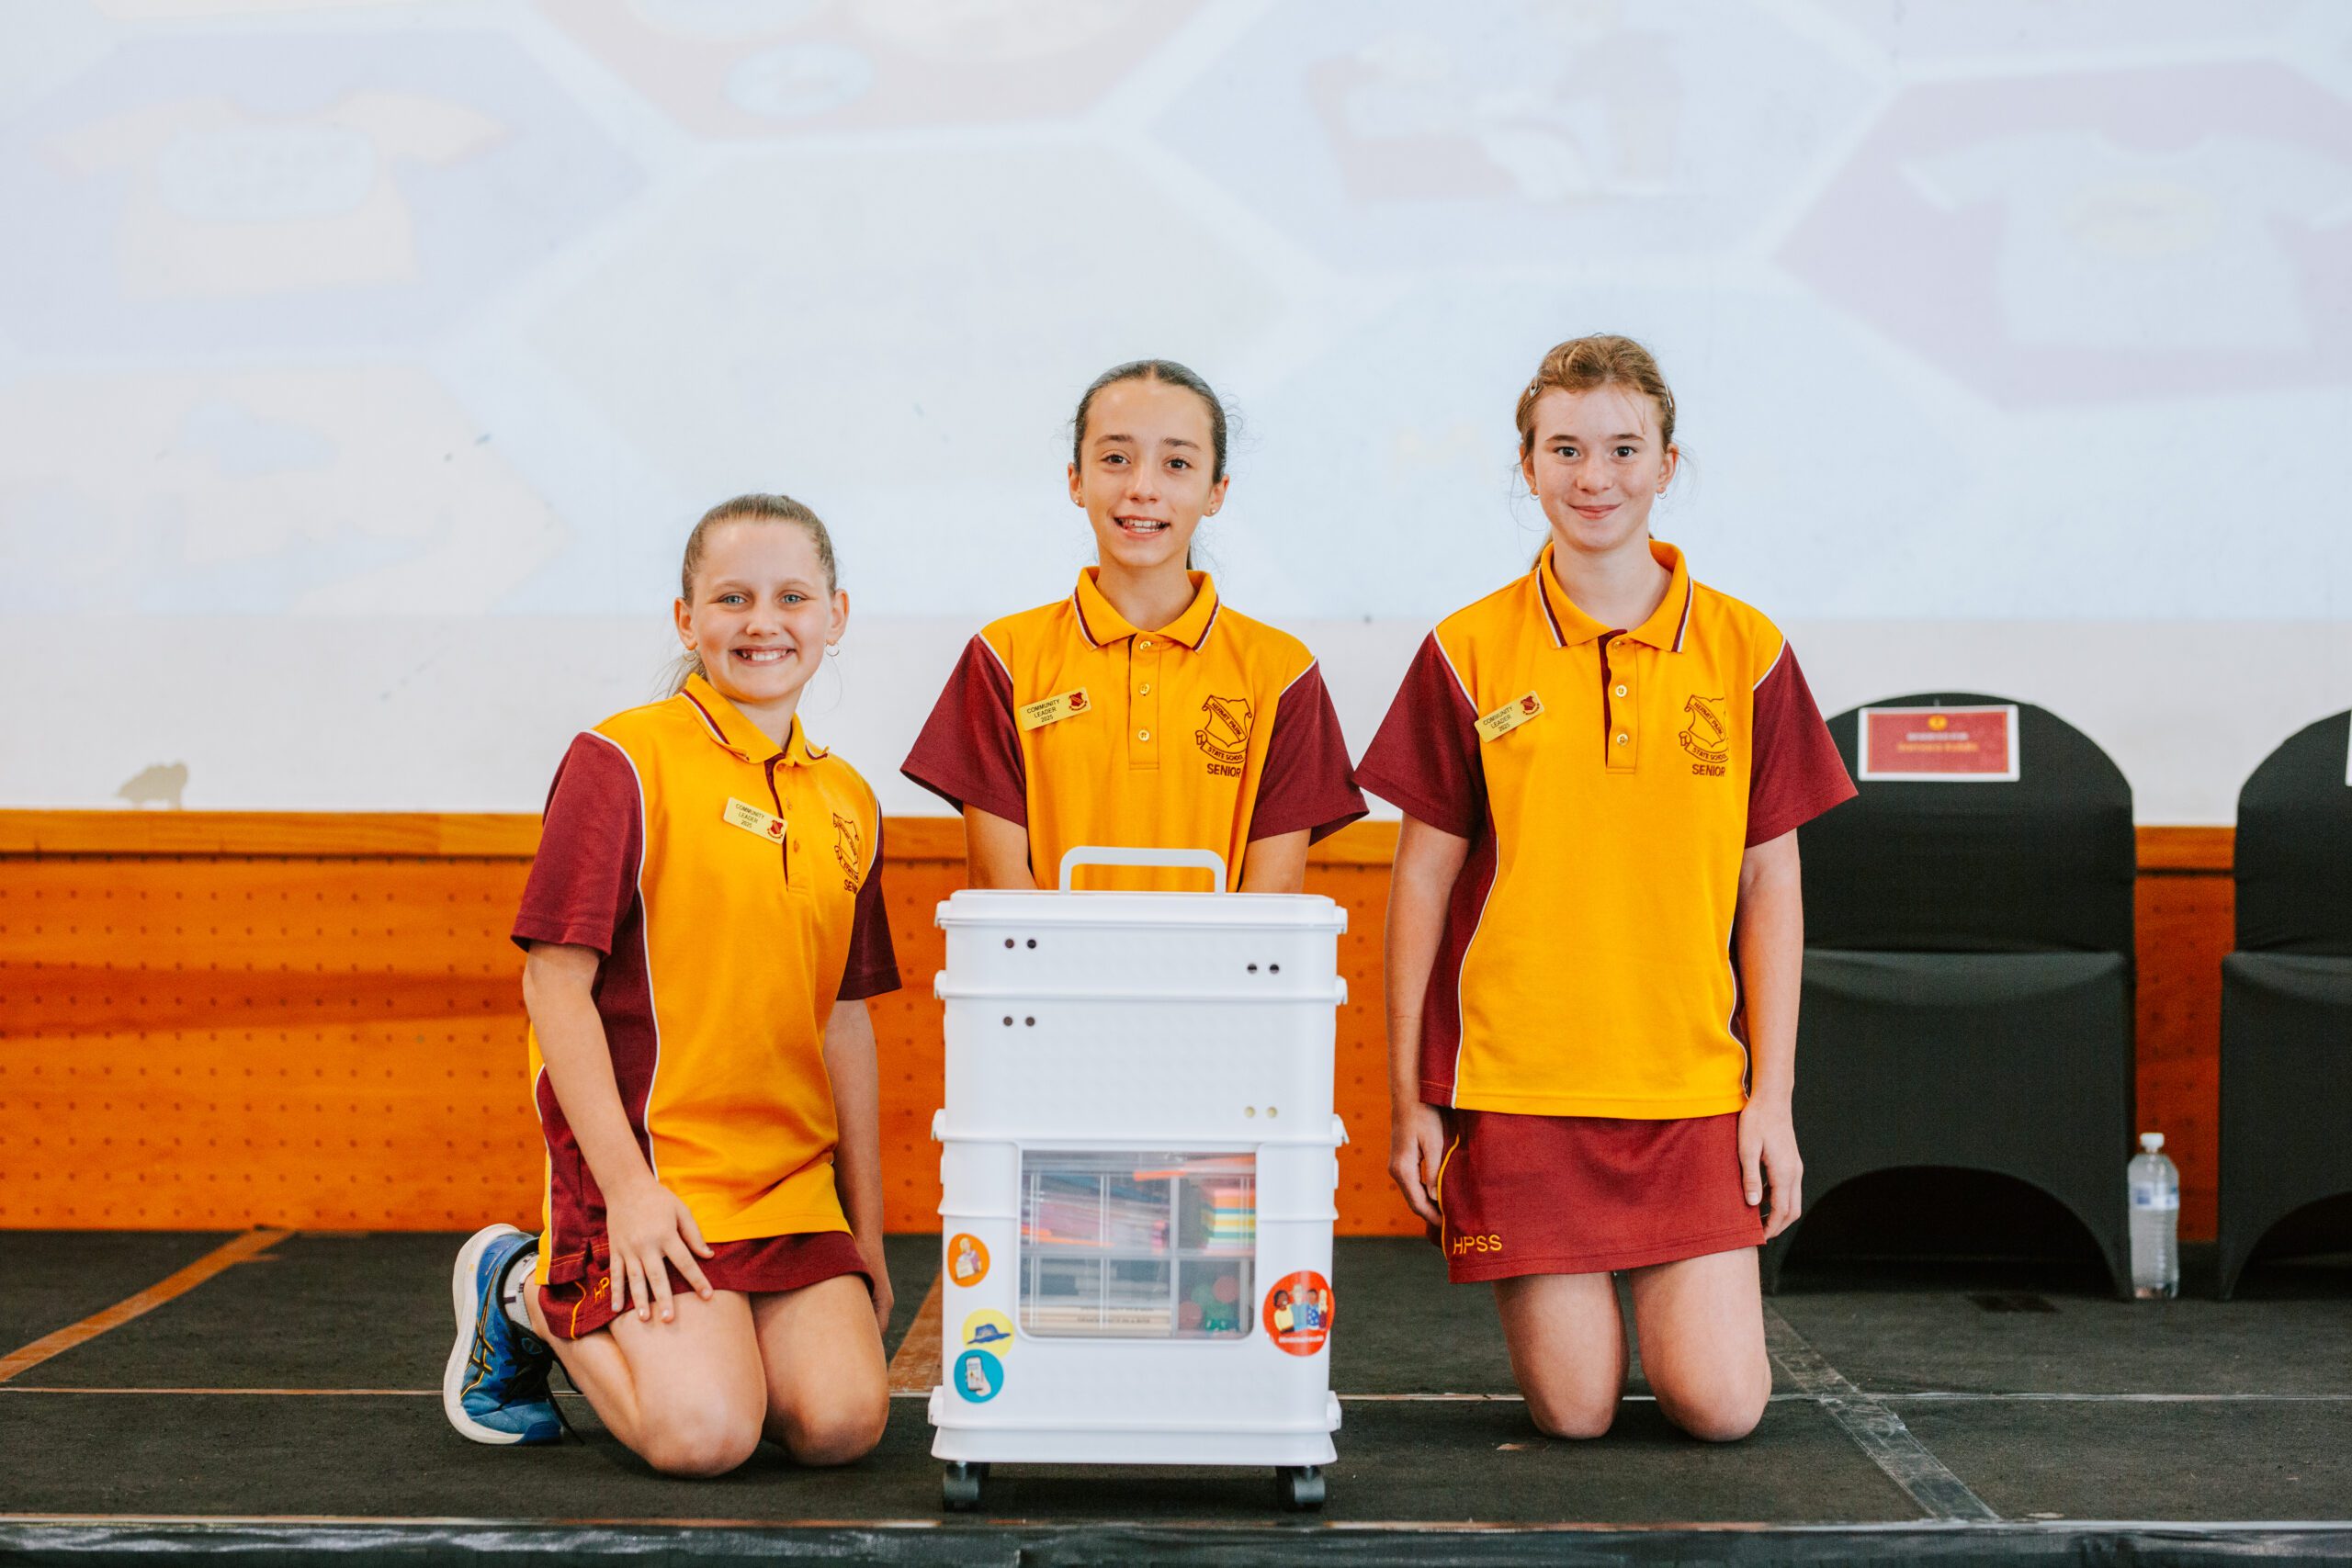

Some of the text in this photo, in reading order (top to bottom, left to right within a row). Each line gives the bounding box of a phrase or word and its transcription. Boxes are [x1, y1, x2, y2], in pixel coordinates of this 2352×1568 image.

[1026, 698, 1060, 714] COMMUNITY
[1034, 706, 1057, 718] LEADER
[1483, 705, 1514, 726] COMMUNITY
[1490, 714, 1512, 729] LEADER
[1207, 746, 1225, 759] STATE
[1691, 747, 1709, 760] STATE
[1206, 763, 1241, 778] SENIOR
[1691, 763, 1726, 777] SENIOR
[735, 803, 765, 819] COMMUNITY
[738, 812, 759, 824] LEADER
[1453, 1234, 1503, 1255] HPSS
[594, 1277, 610, 1303] HP
